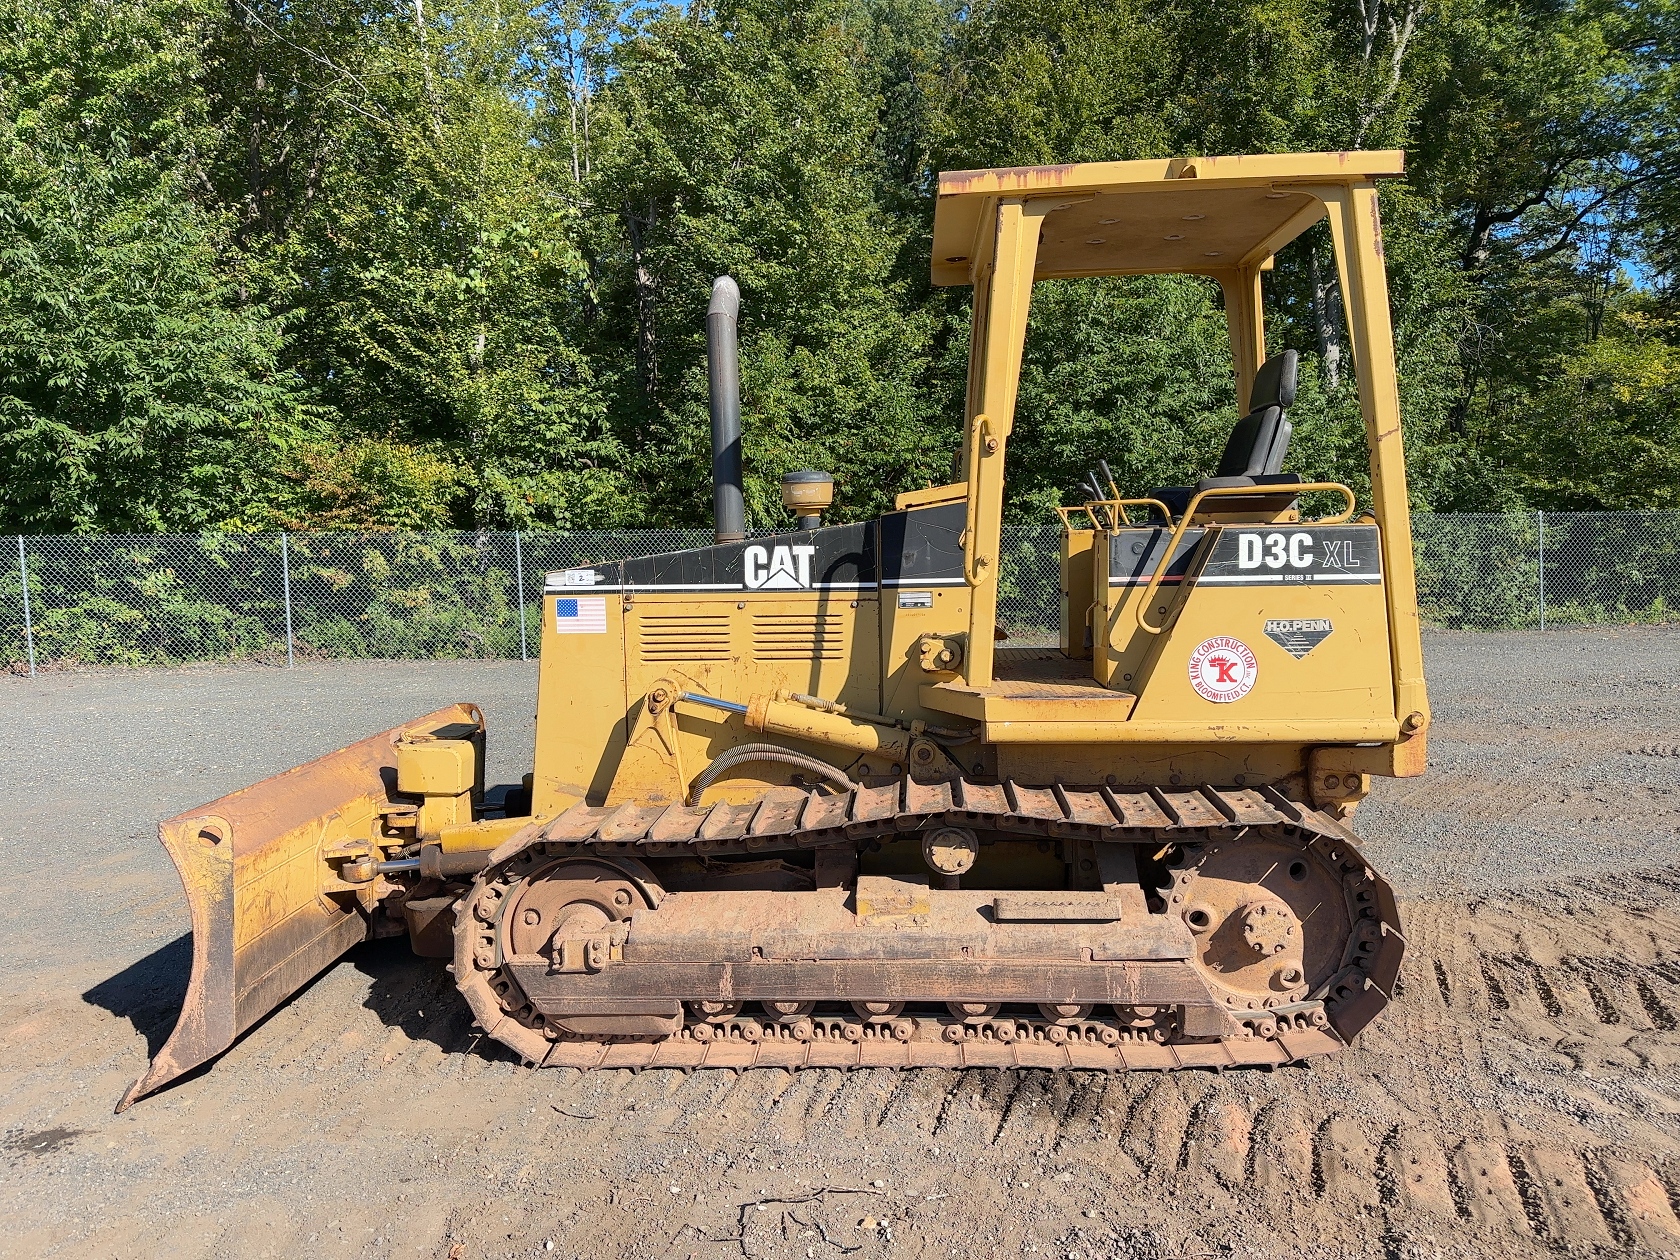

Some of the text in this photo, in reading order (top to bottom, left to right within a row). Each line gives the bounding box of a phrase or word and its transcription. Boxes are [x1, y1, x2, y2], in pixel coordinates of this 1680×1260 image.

[744, 545, 815, 589] CAT
[1238, 532, 1360, 569] D3C XL
[1189, 656, 1202, 681] KING
[1197, 638, 1256, 669] CONSTRUCTION
[1215, 662, 1238, 683] K
